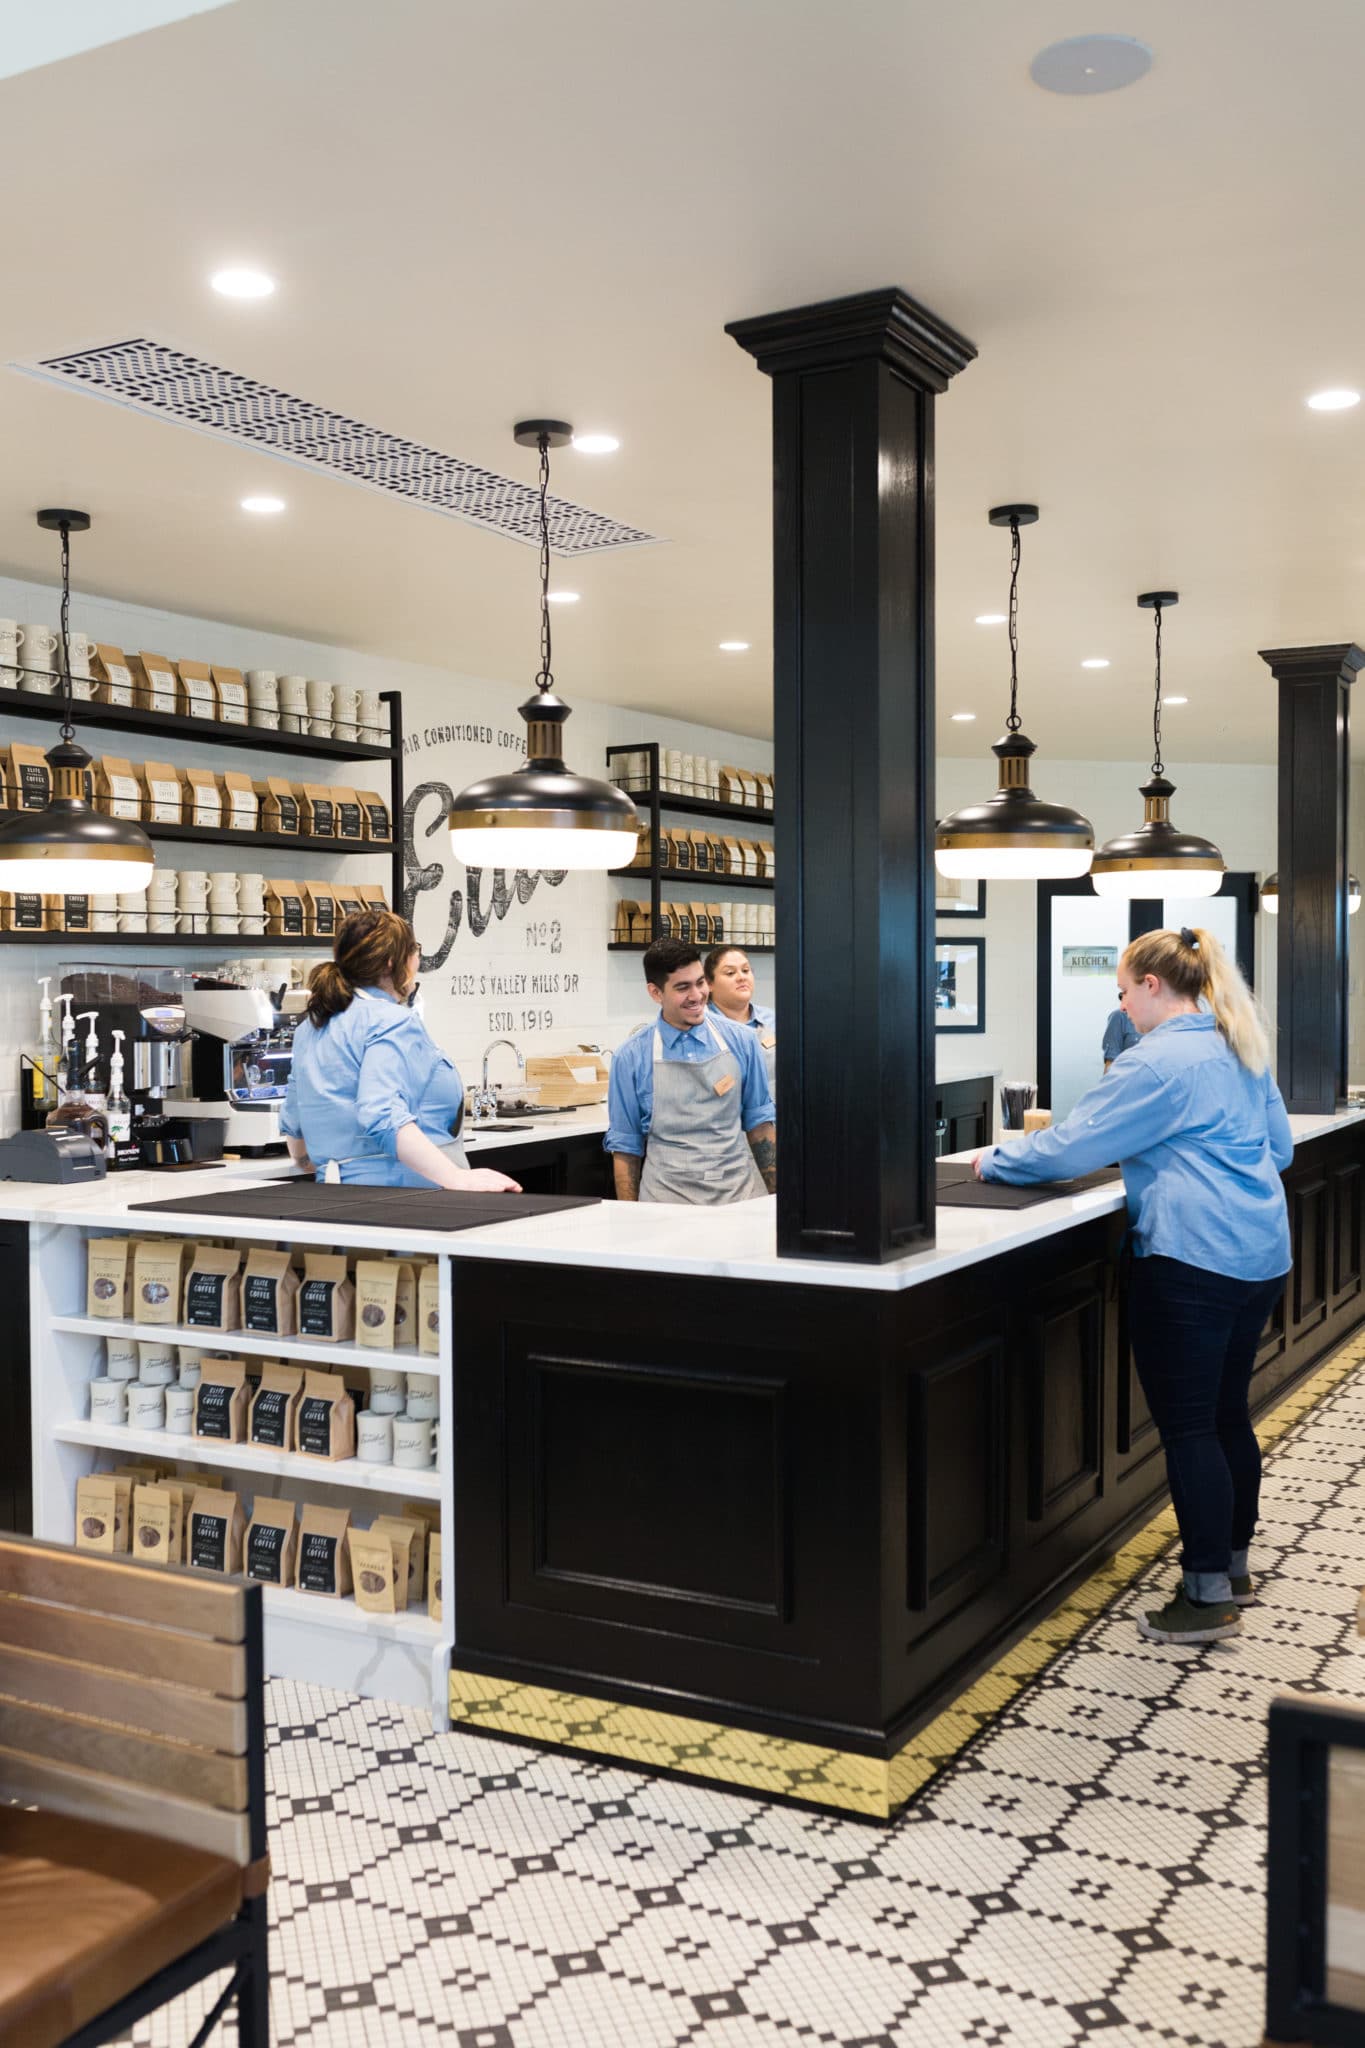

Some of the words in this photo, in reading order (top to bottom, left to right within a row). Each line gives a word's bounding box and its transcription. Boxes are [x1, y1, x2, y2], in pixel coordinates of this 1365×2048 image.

[424, 725, 493, 747] CONDITIONED
[497, 730, 527, 755] COFFE
[1071, 956, 1108, 966] KITCHEN
[451, 975, 475, 996] 2132
[480, 975, 486, 995] S
[491, 974, 527, 995] VALLEY
[532, 974, 559, 994] MILLS
[564, 973, 579, 993] DR
[489, 1011, 517, 1032] ESTD.
[521, 1010, 553, 1032] 1919
[193, 1284, 216, 1294] COFFEE
[249, 1290, 271, 1300] COFFEE
[304, 1292, 326, 1302] COFFEE
[202, 1396, 225, 1406] COFFEE
[258, 1403, 280, 1414] COFFEE
[201, 1517, 217, 1526] ELITE
[197, 1528, 219, 1539] COFFEE
[259, 1527, 277, 1536] ELITE
[254, 1538, 276, 1549] COFFEE
[311, 1537, 328, 1546] ELITE
[306, 1548, 328, 1559] COFFEE
